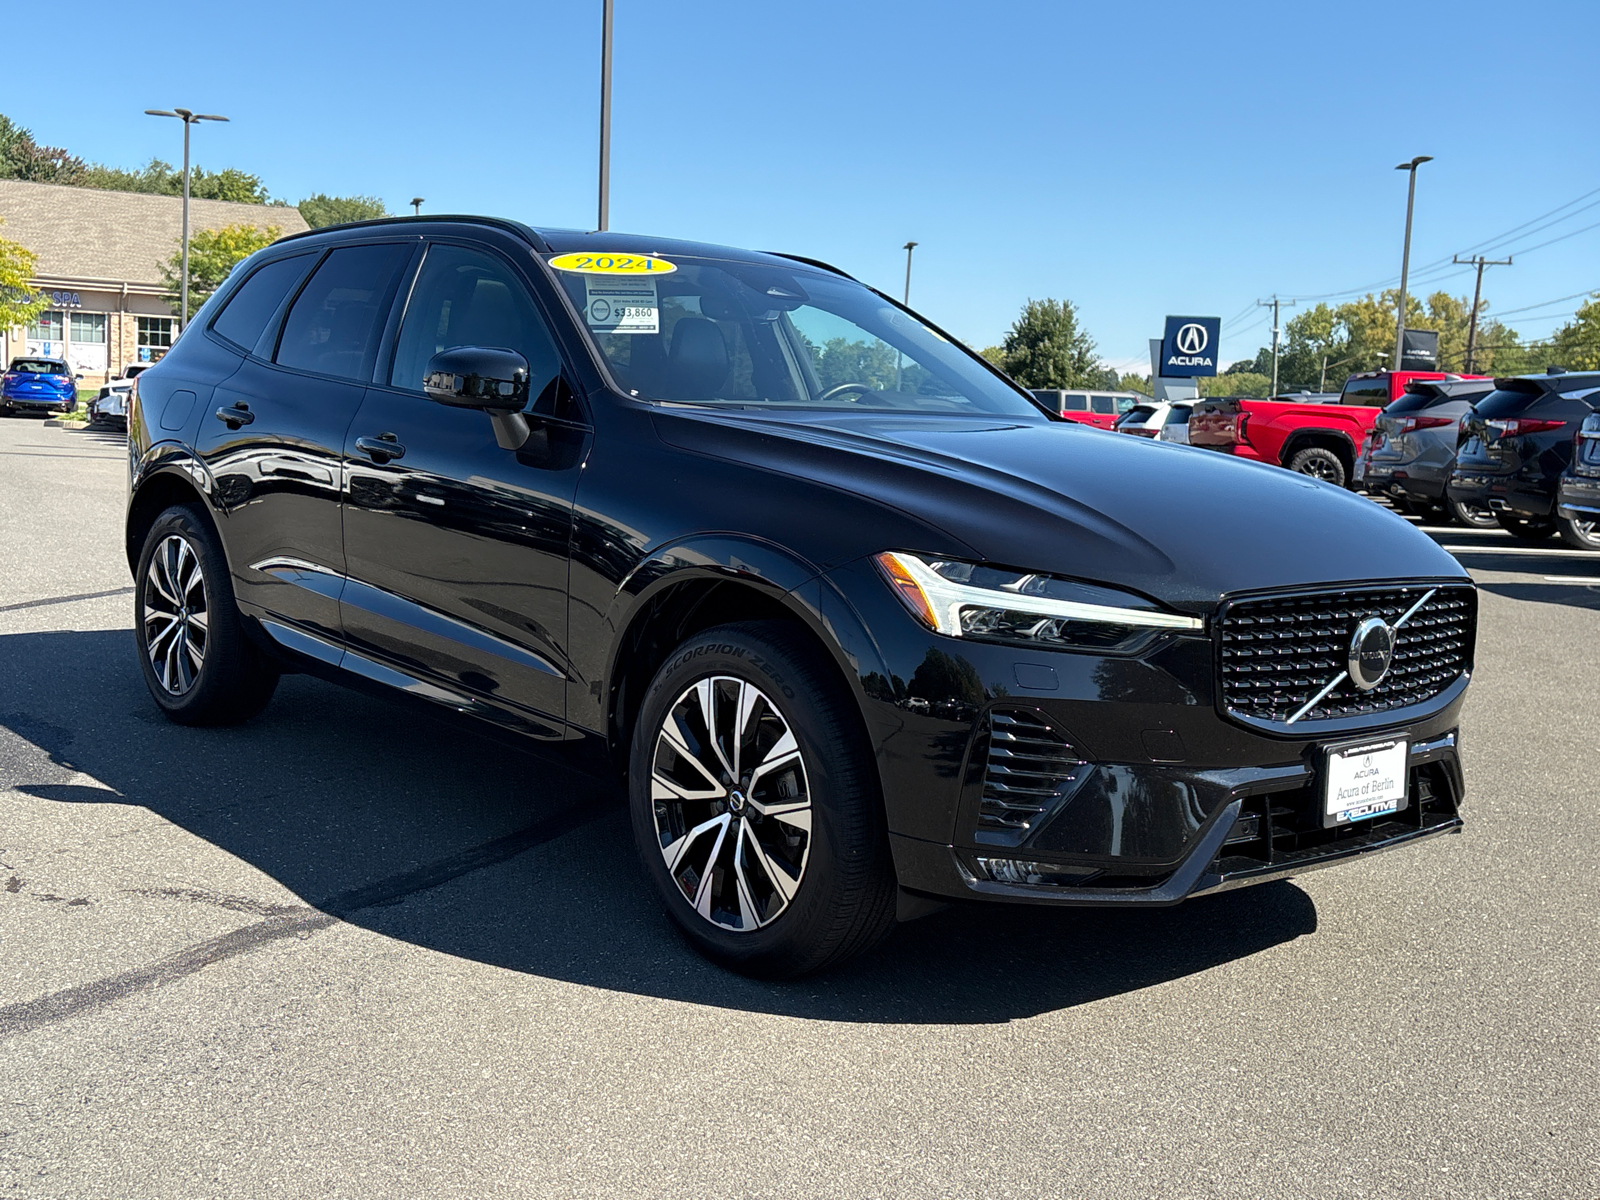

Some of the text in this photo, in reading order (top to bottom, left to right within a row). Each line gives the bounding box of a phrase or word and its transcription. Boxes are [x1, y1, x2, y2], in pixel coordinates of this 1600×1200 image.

[575, 257, 656, 271] 2024
[52, 291, 82, 307] SPA
[614, 307, 653, 319] $33,860
[1168, 356, 1213, 367] ACURA
[665, 643, 796, 700] SCORPION ZERO
[1353, 767, 1380, 780] ACURA
[1336, 777, 1395, 801] Acura of Berlin
[1336, 800, 1398, 822] EXECUTIVE
